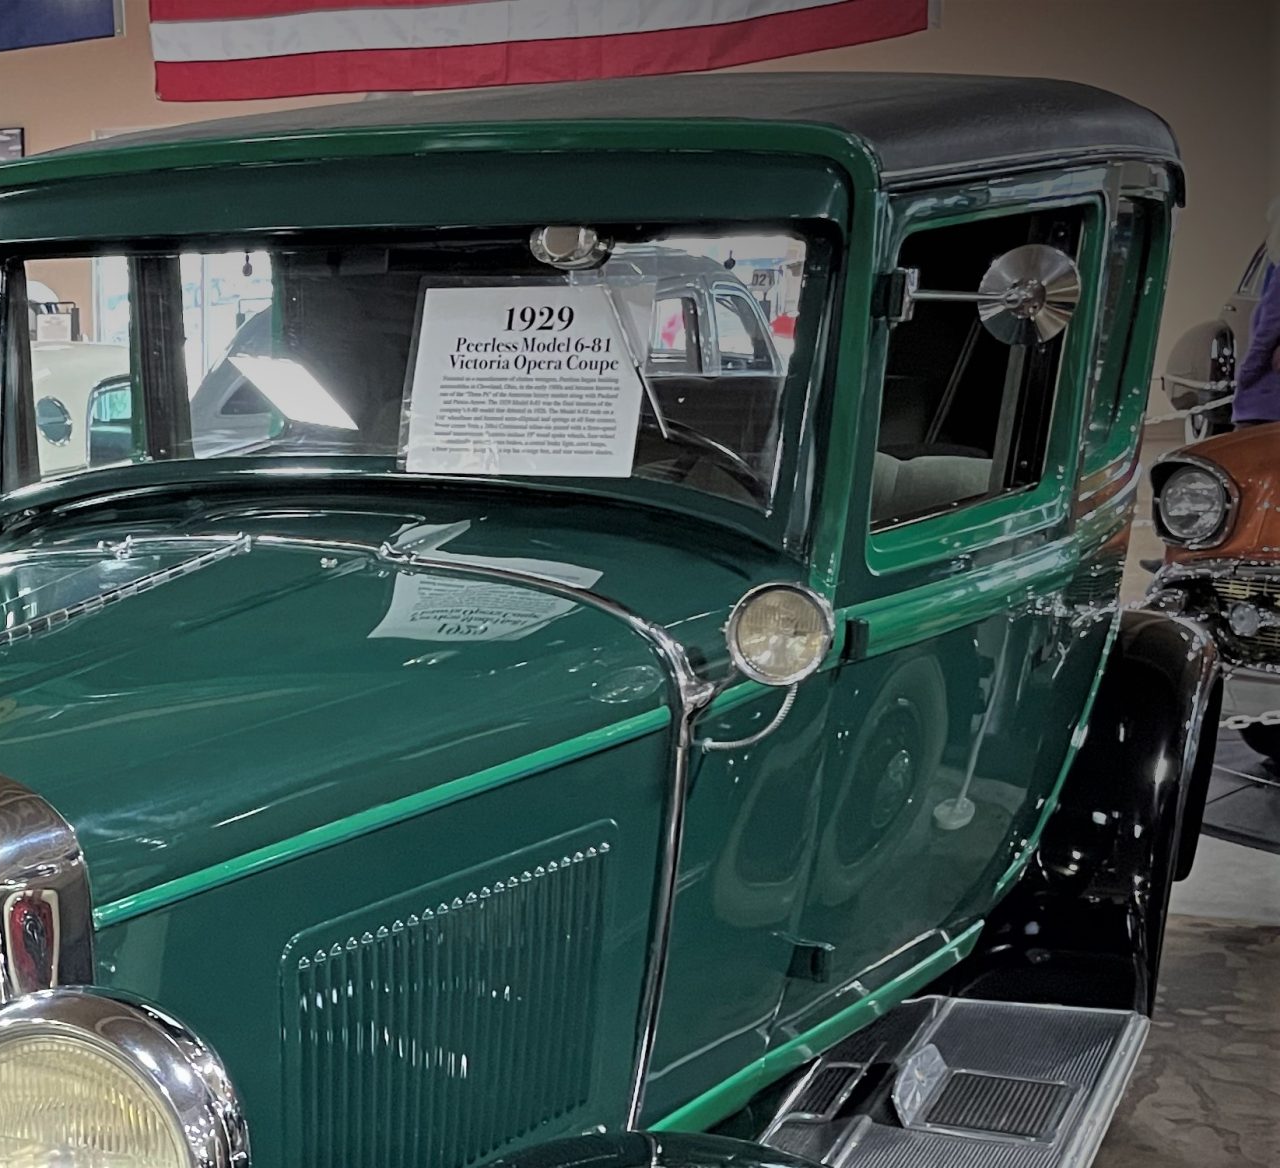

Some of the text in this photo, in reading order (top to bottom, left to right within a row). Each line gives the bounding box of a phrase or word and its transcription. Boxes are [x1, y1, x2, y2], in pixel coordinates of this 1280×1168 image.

[504, 306, 575, 331] 1929
[455, 337, 612, 353] Peerless Model 6-81
[449, 354, 619, 375] Victoria Opera Coupe
